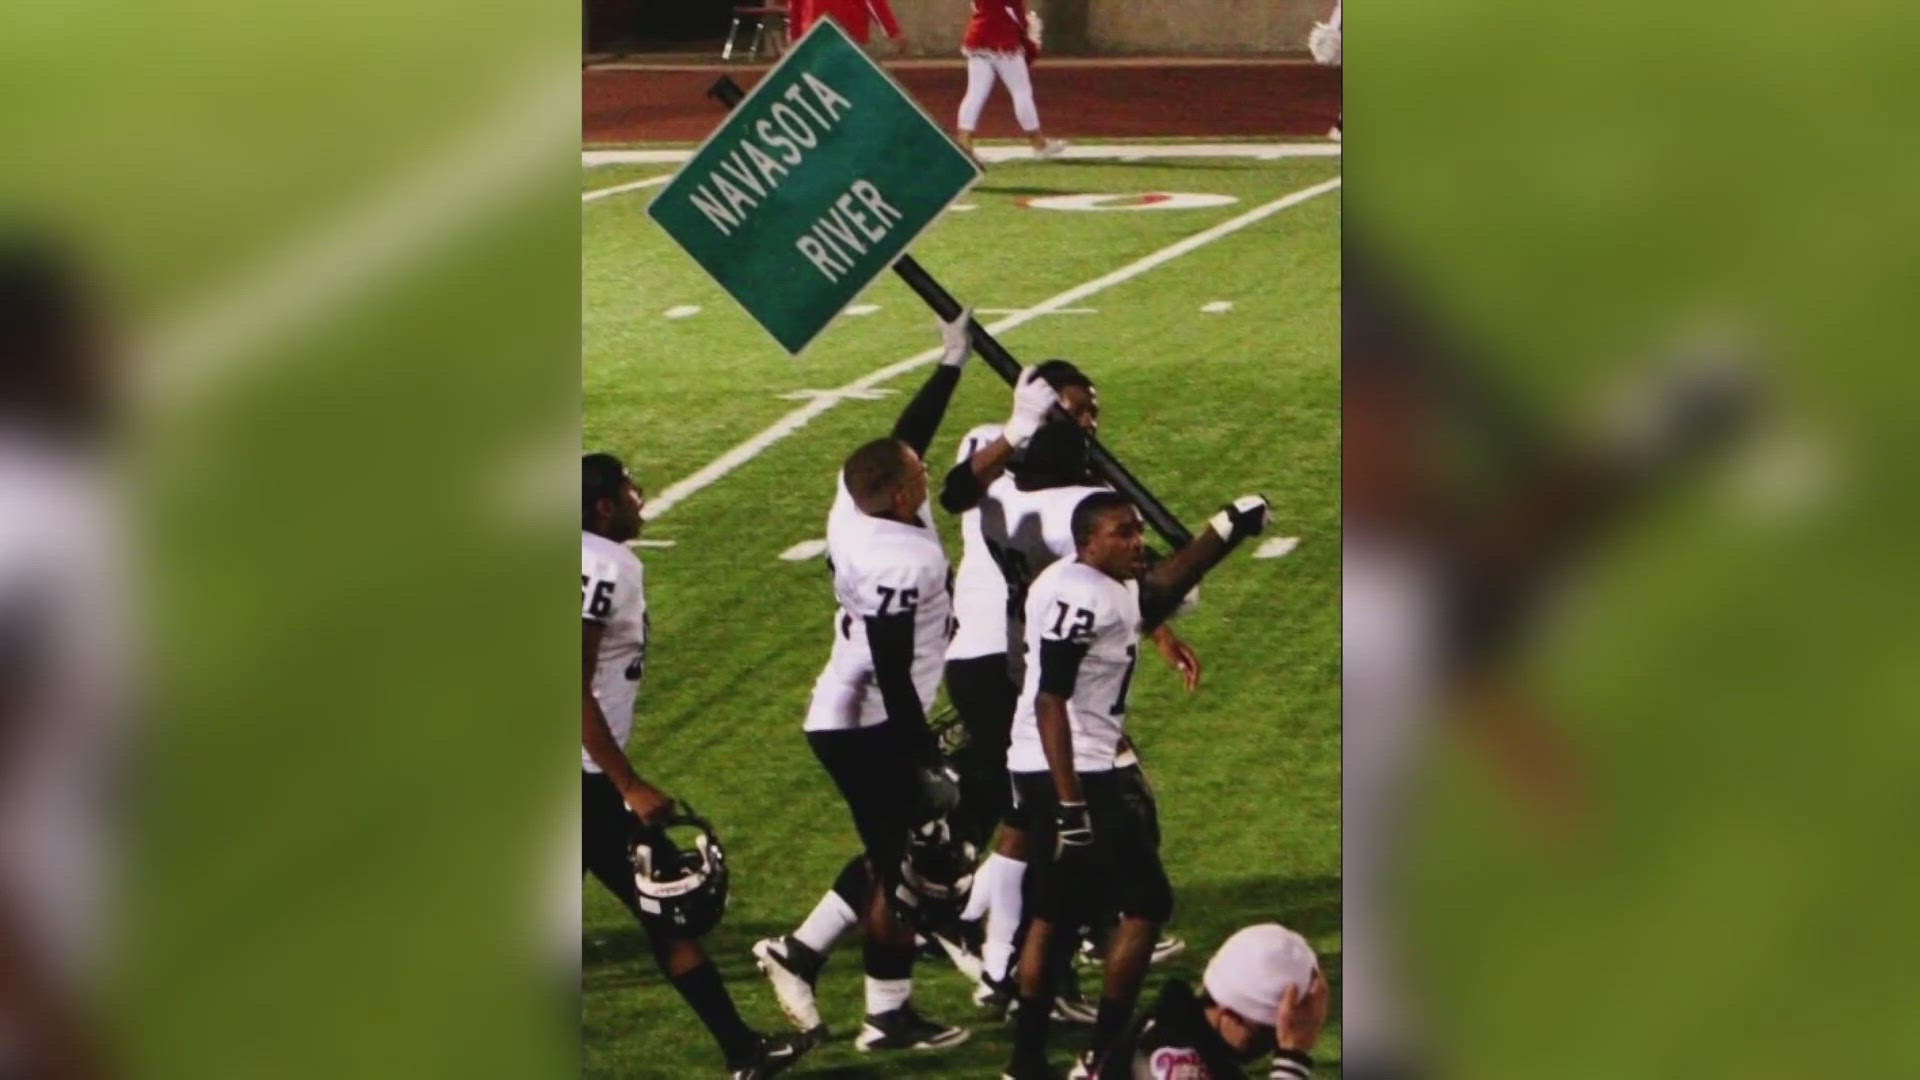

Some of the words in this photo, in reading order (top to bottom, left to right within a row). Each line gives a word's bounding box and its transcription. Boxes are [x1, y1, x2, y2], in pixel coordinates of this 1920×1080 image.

[689, 72, 852, 236] NAVASOTA
[796, 179, 903, 284] RIVER
[1050, 600, 1097, 640] 12
